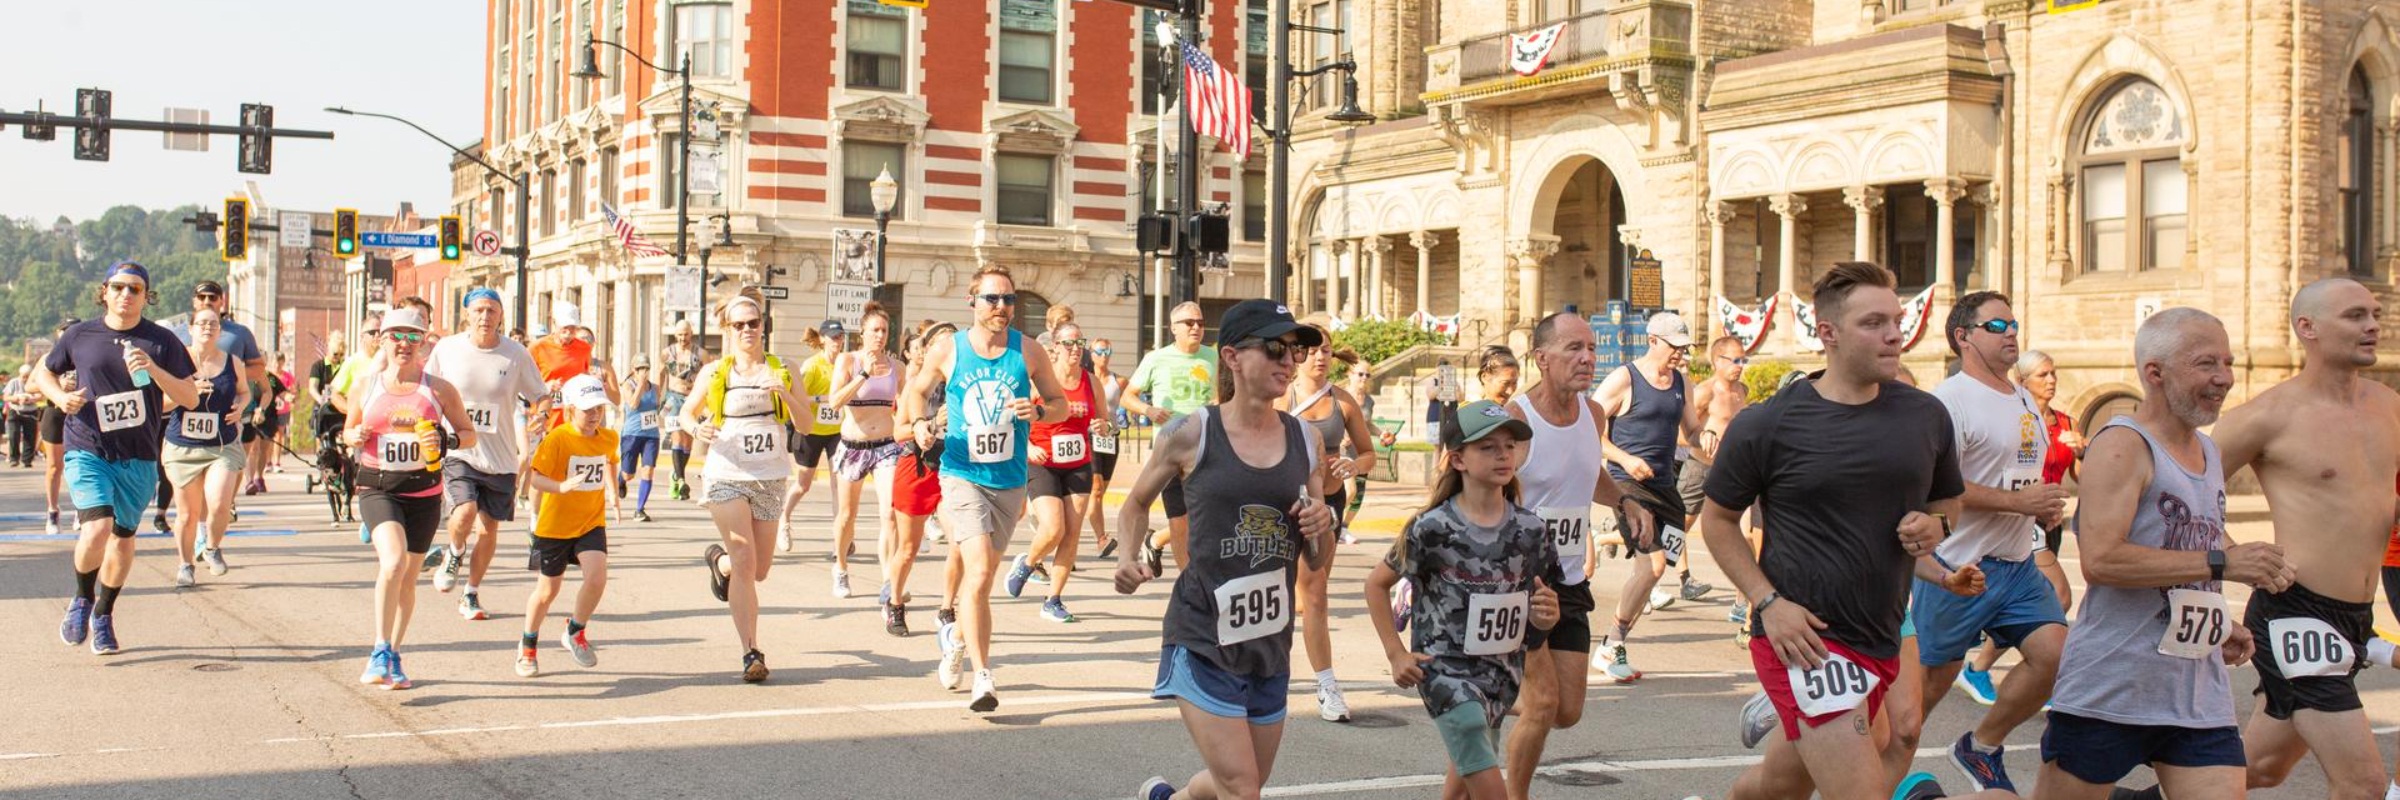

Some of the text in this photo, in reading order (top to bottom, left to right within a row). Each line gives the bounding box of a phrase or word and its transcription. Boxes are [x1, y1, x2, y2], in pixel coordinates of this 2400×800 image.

[381, 234, 432, 246] E Diamond St
[830, 288, 868, 299] LEFT LANE
[837, 302, 861, 312] MUST
[1617, 329, 1647, 346] Coun
[995, 369, 1020, 390] CLUB
[103, 399, 140, 423] 523
[466, 409, 491, 426] 541
[820, 407, 840, 420] 534
[187, 418, 213, 434] 540
[385, 441, 421, 463] 600
[744, 433, 775, 455] 524
[975, 432, 1008, 455] 567
[1057, 440, 1081, 457] 583
[1546, 518, 1582, 546] 594
[1220, 537, 1296, 561] BUTLER
[1229, 584, 1281, 629] 595
[1478, 605, 1521, 642] 596
[2175, 604, 2224, 646] 578
[2282, 629, 2344, 664] 606
[1802, 659, 1869, 701] 509
